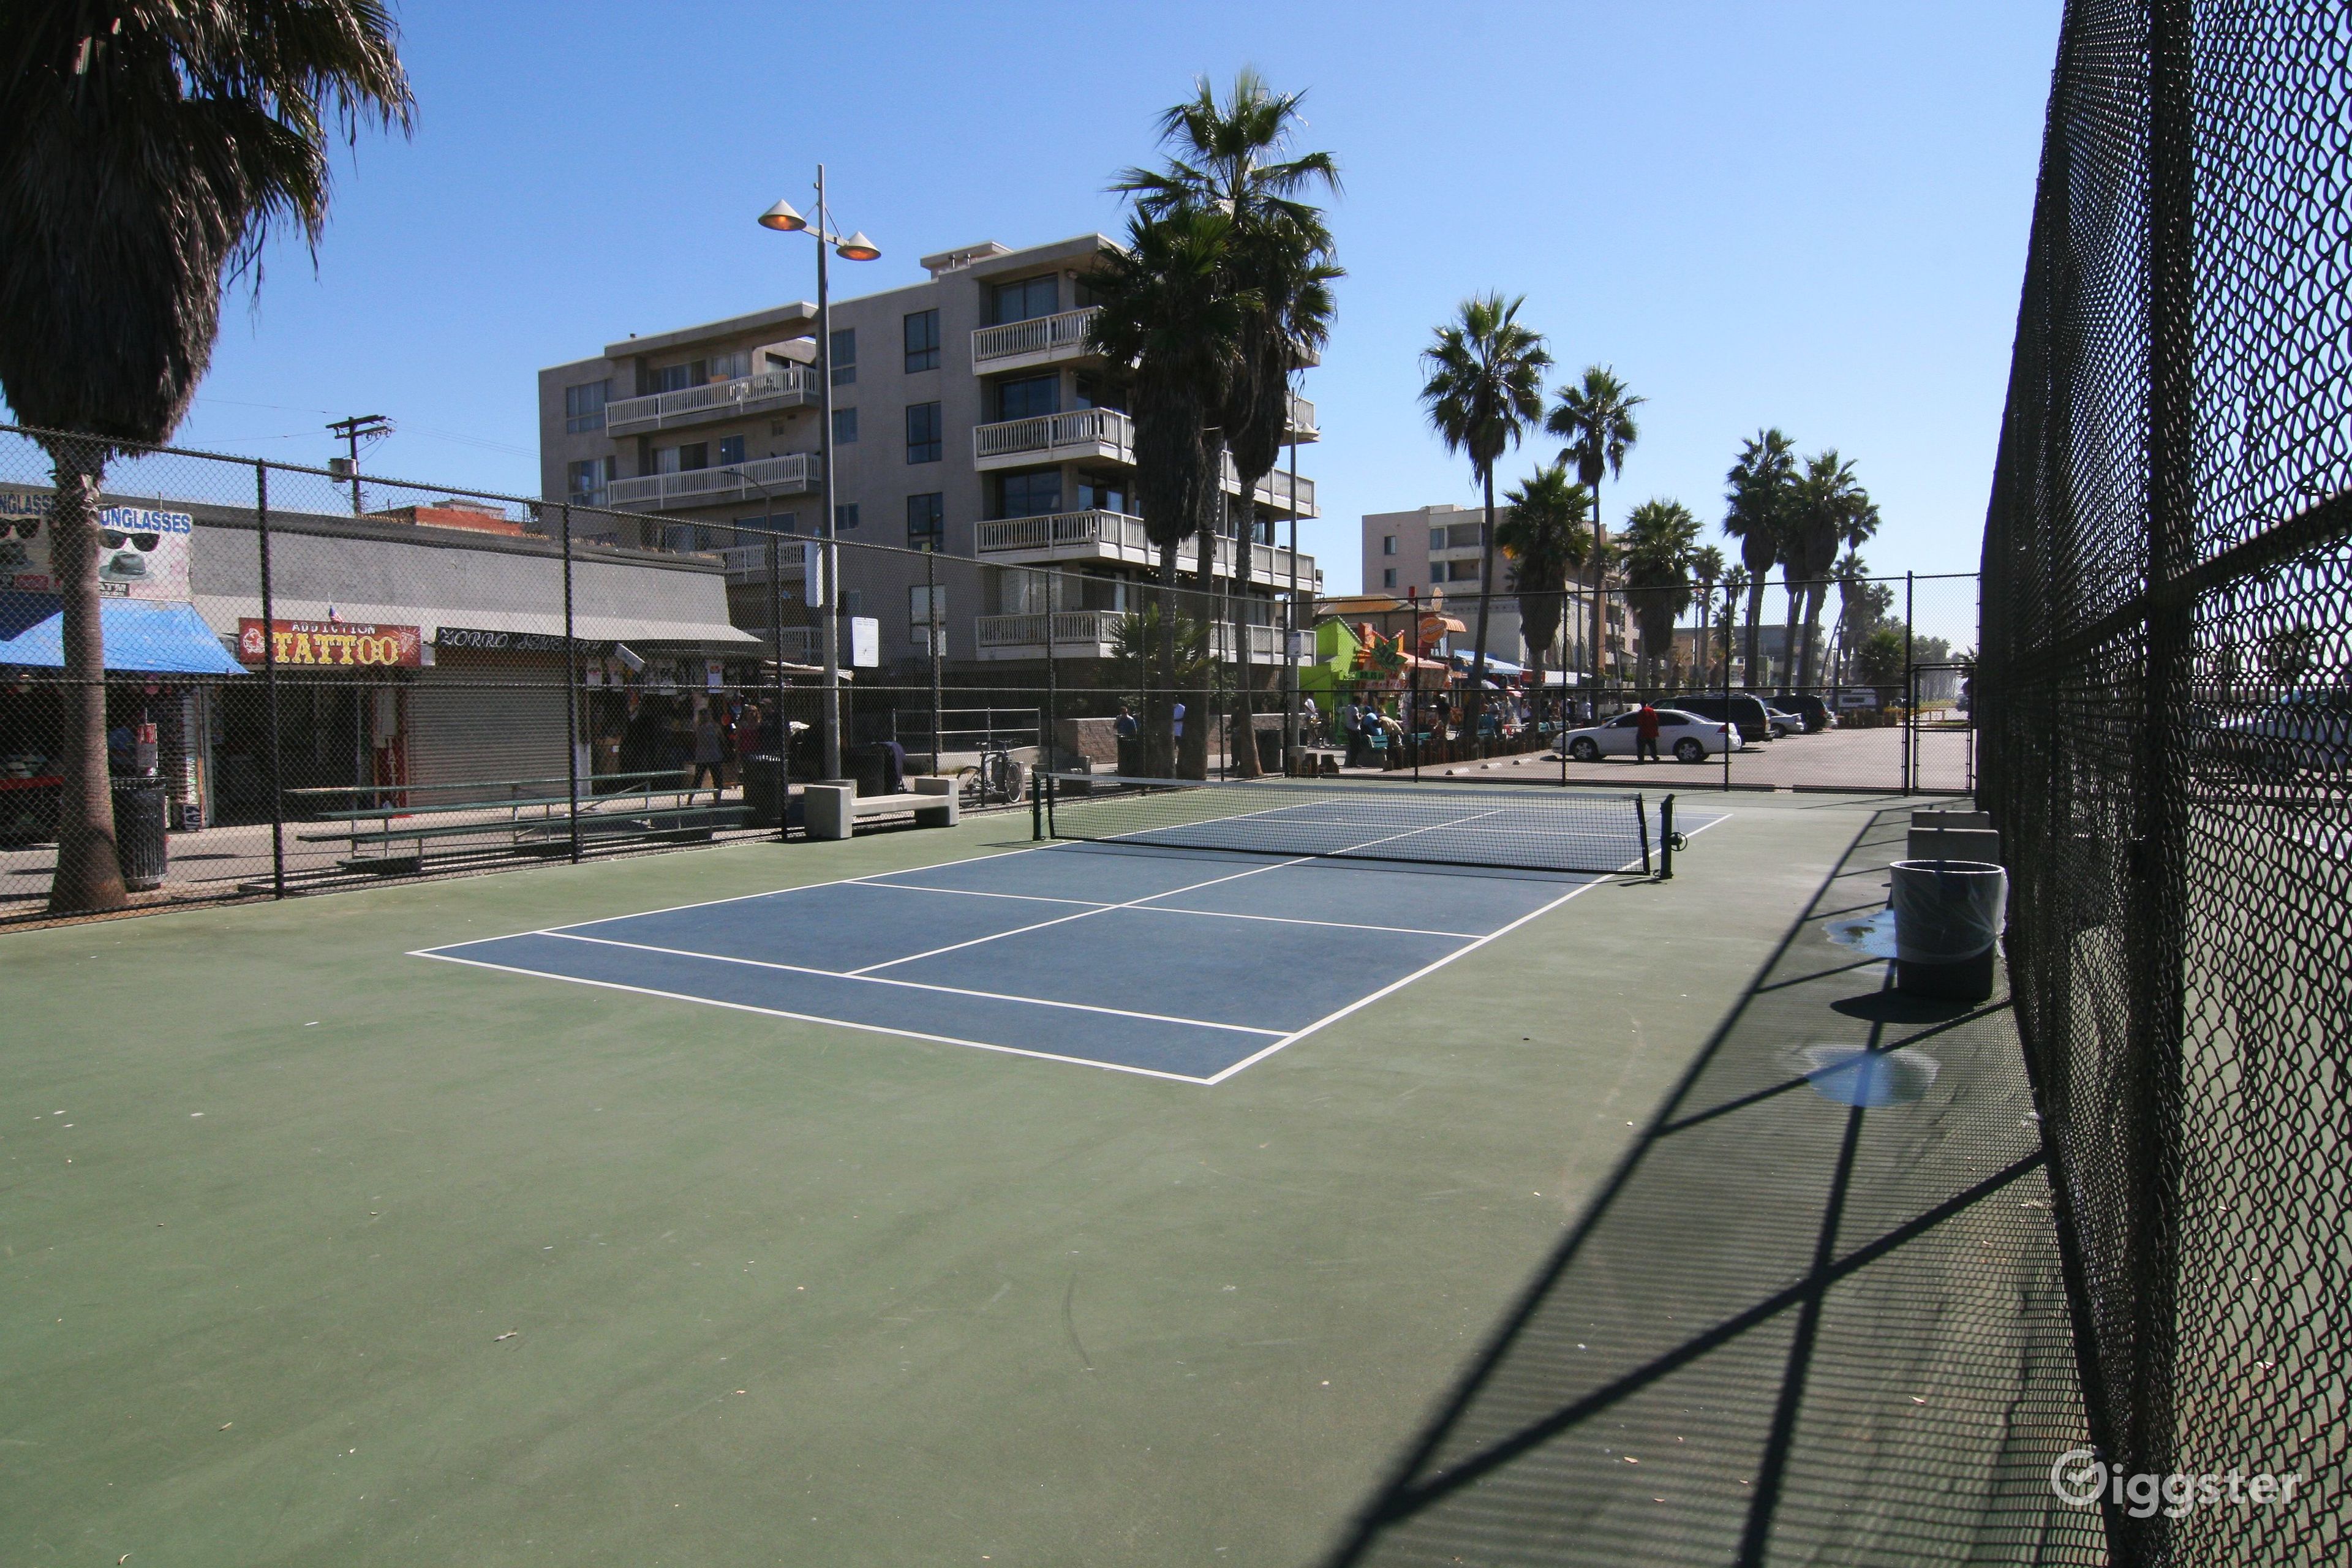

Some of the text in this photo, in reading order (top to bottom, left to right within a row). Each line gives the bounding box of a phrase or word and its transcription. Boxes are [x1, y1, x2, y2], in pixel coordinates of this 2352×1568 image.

[0, 494, 58, 515] NGLASS
[292, 621, 375, 635] ADDICTION
[440, 627, 508, 648] ZORRO
[273, 632, 399, 665] TATTOO
